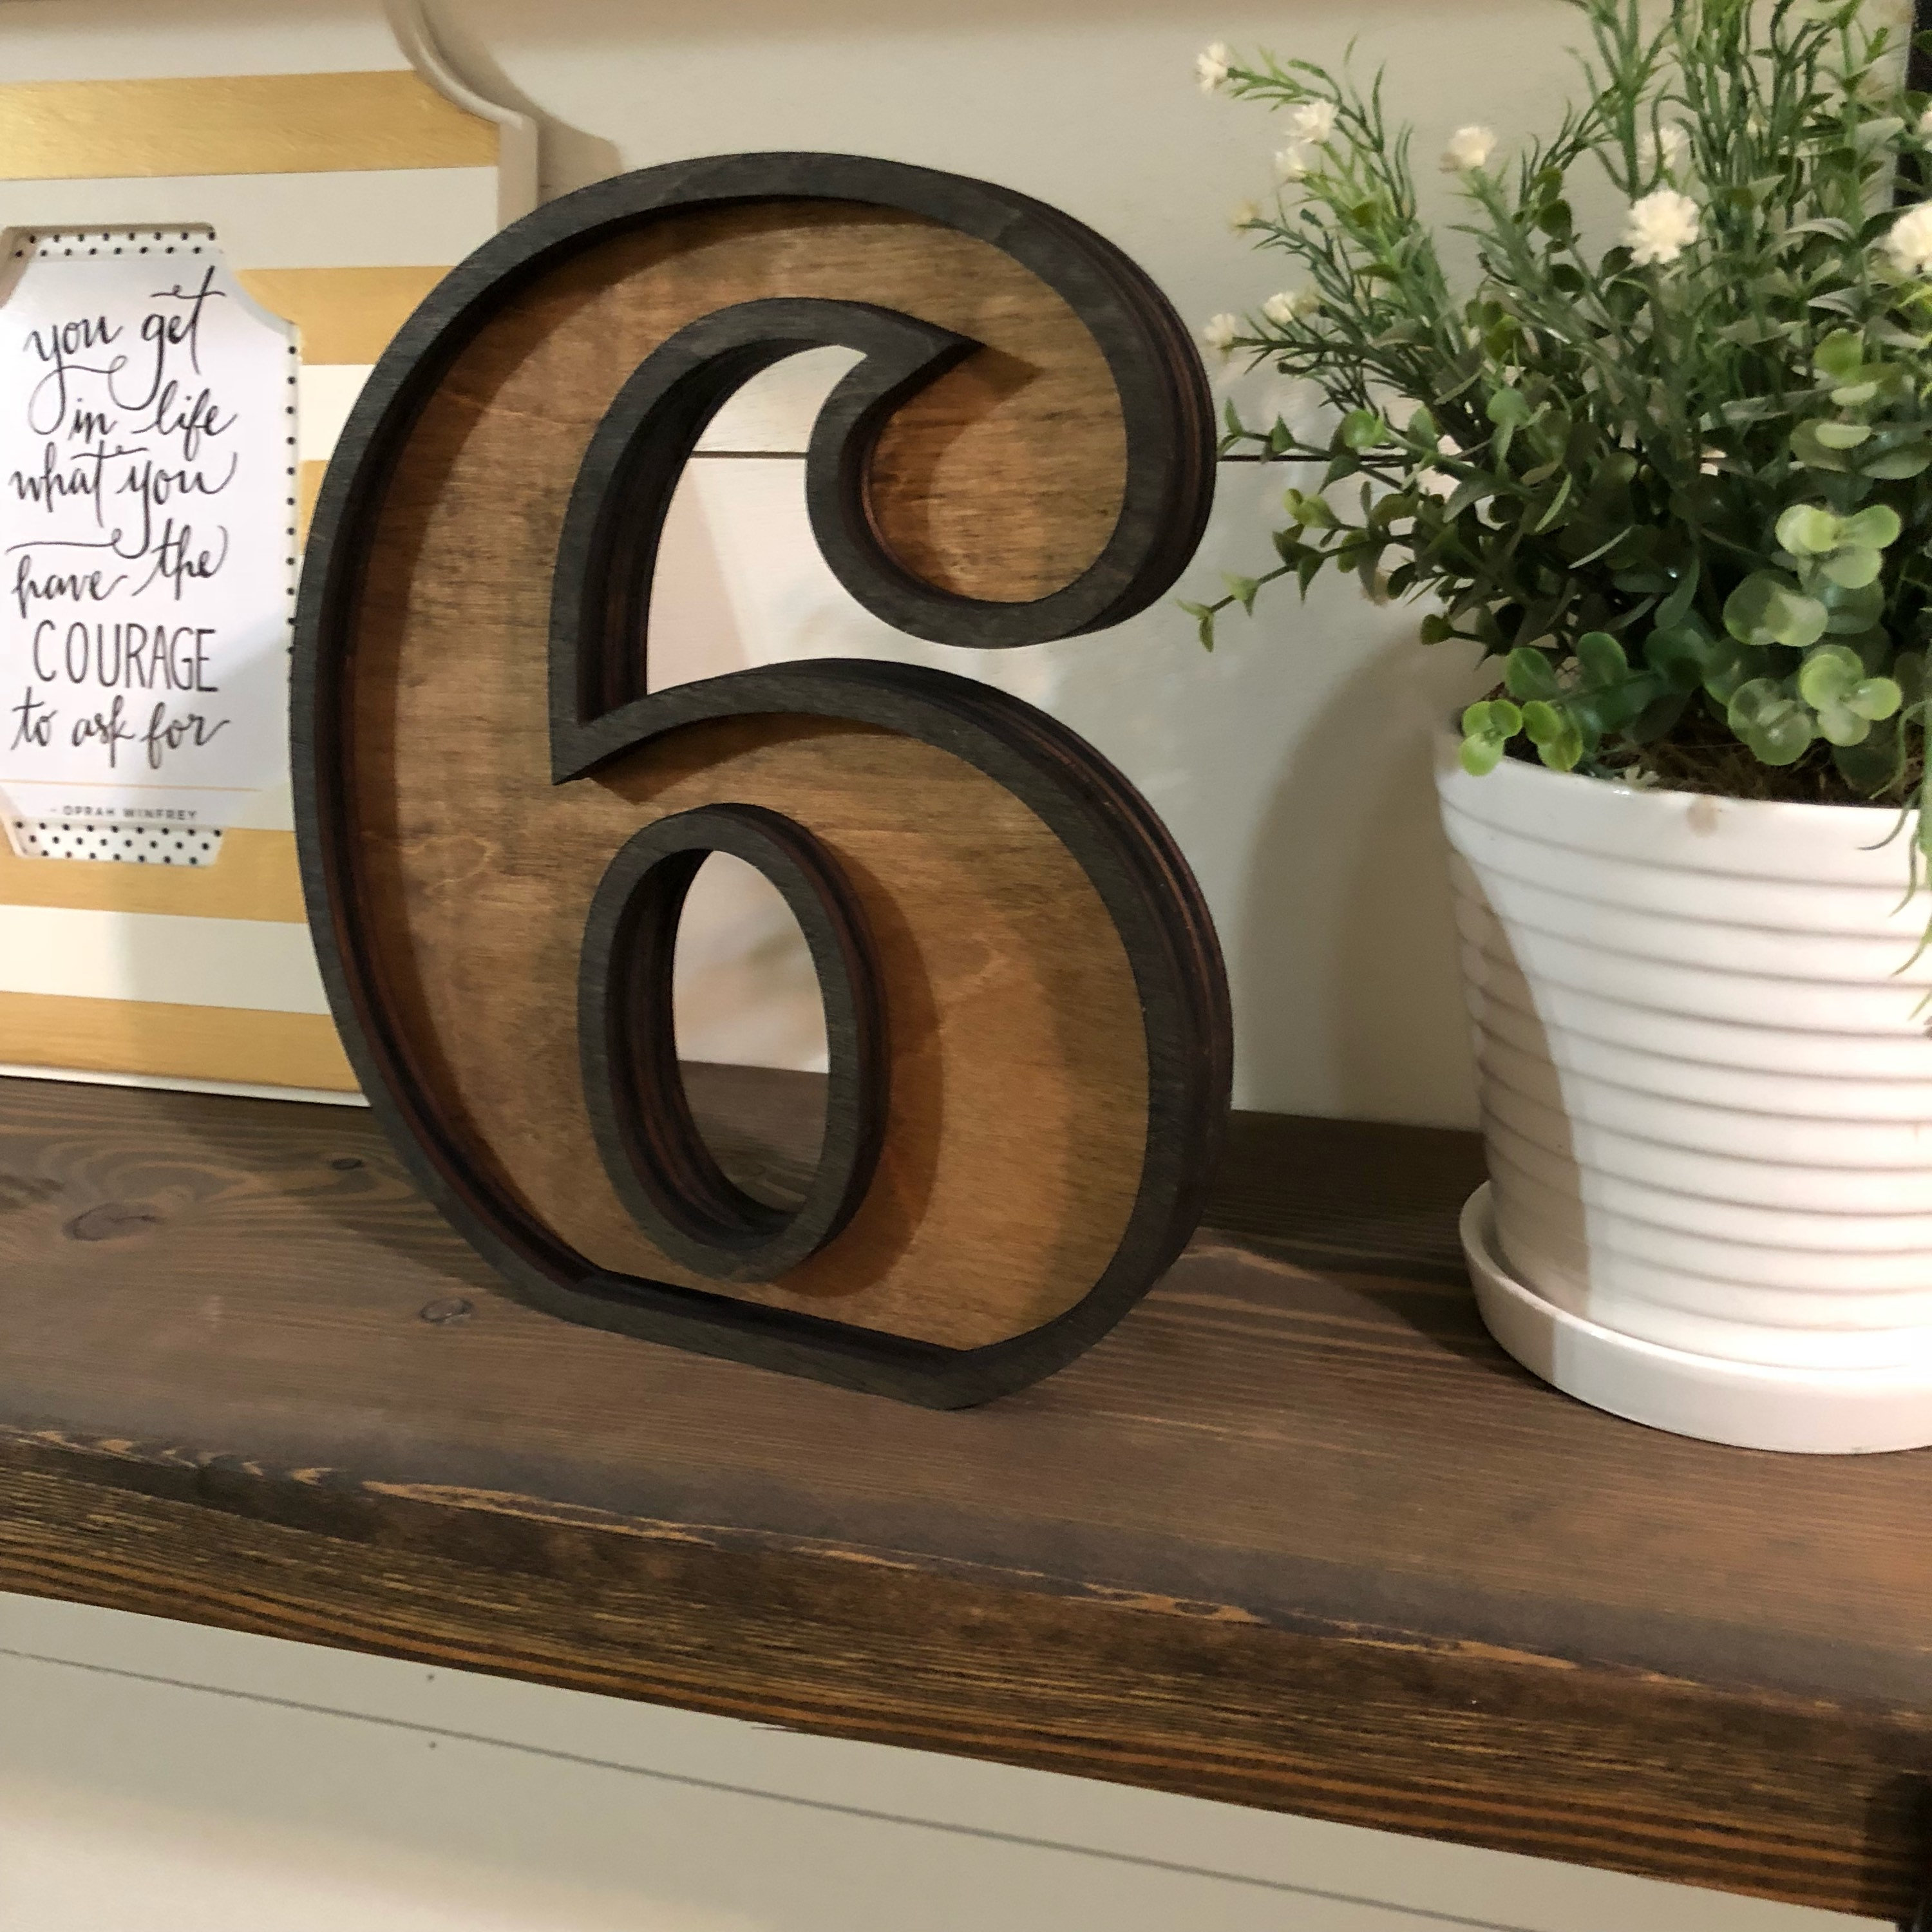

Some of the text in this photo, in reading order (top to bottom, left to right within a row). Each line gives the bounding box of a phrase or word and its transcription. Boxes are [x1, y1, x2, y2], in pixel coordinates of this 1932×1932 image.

[23, 265, 226, 435] you get
[68, 380, 238, 461] in life
[9, 440, 148, 527] what
[11, 518, 229, 619] have the
[33, 620, 218, 692] COURAGE
[10, 687, 231, 770] to ask for
[63, 805, 115, 816] OPRAH
[123, 808, 197, 820] WINFREY
[290, 151, 1234, 1410] 6
